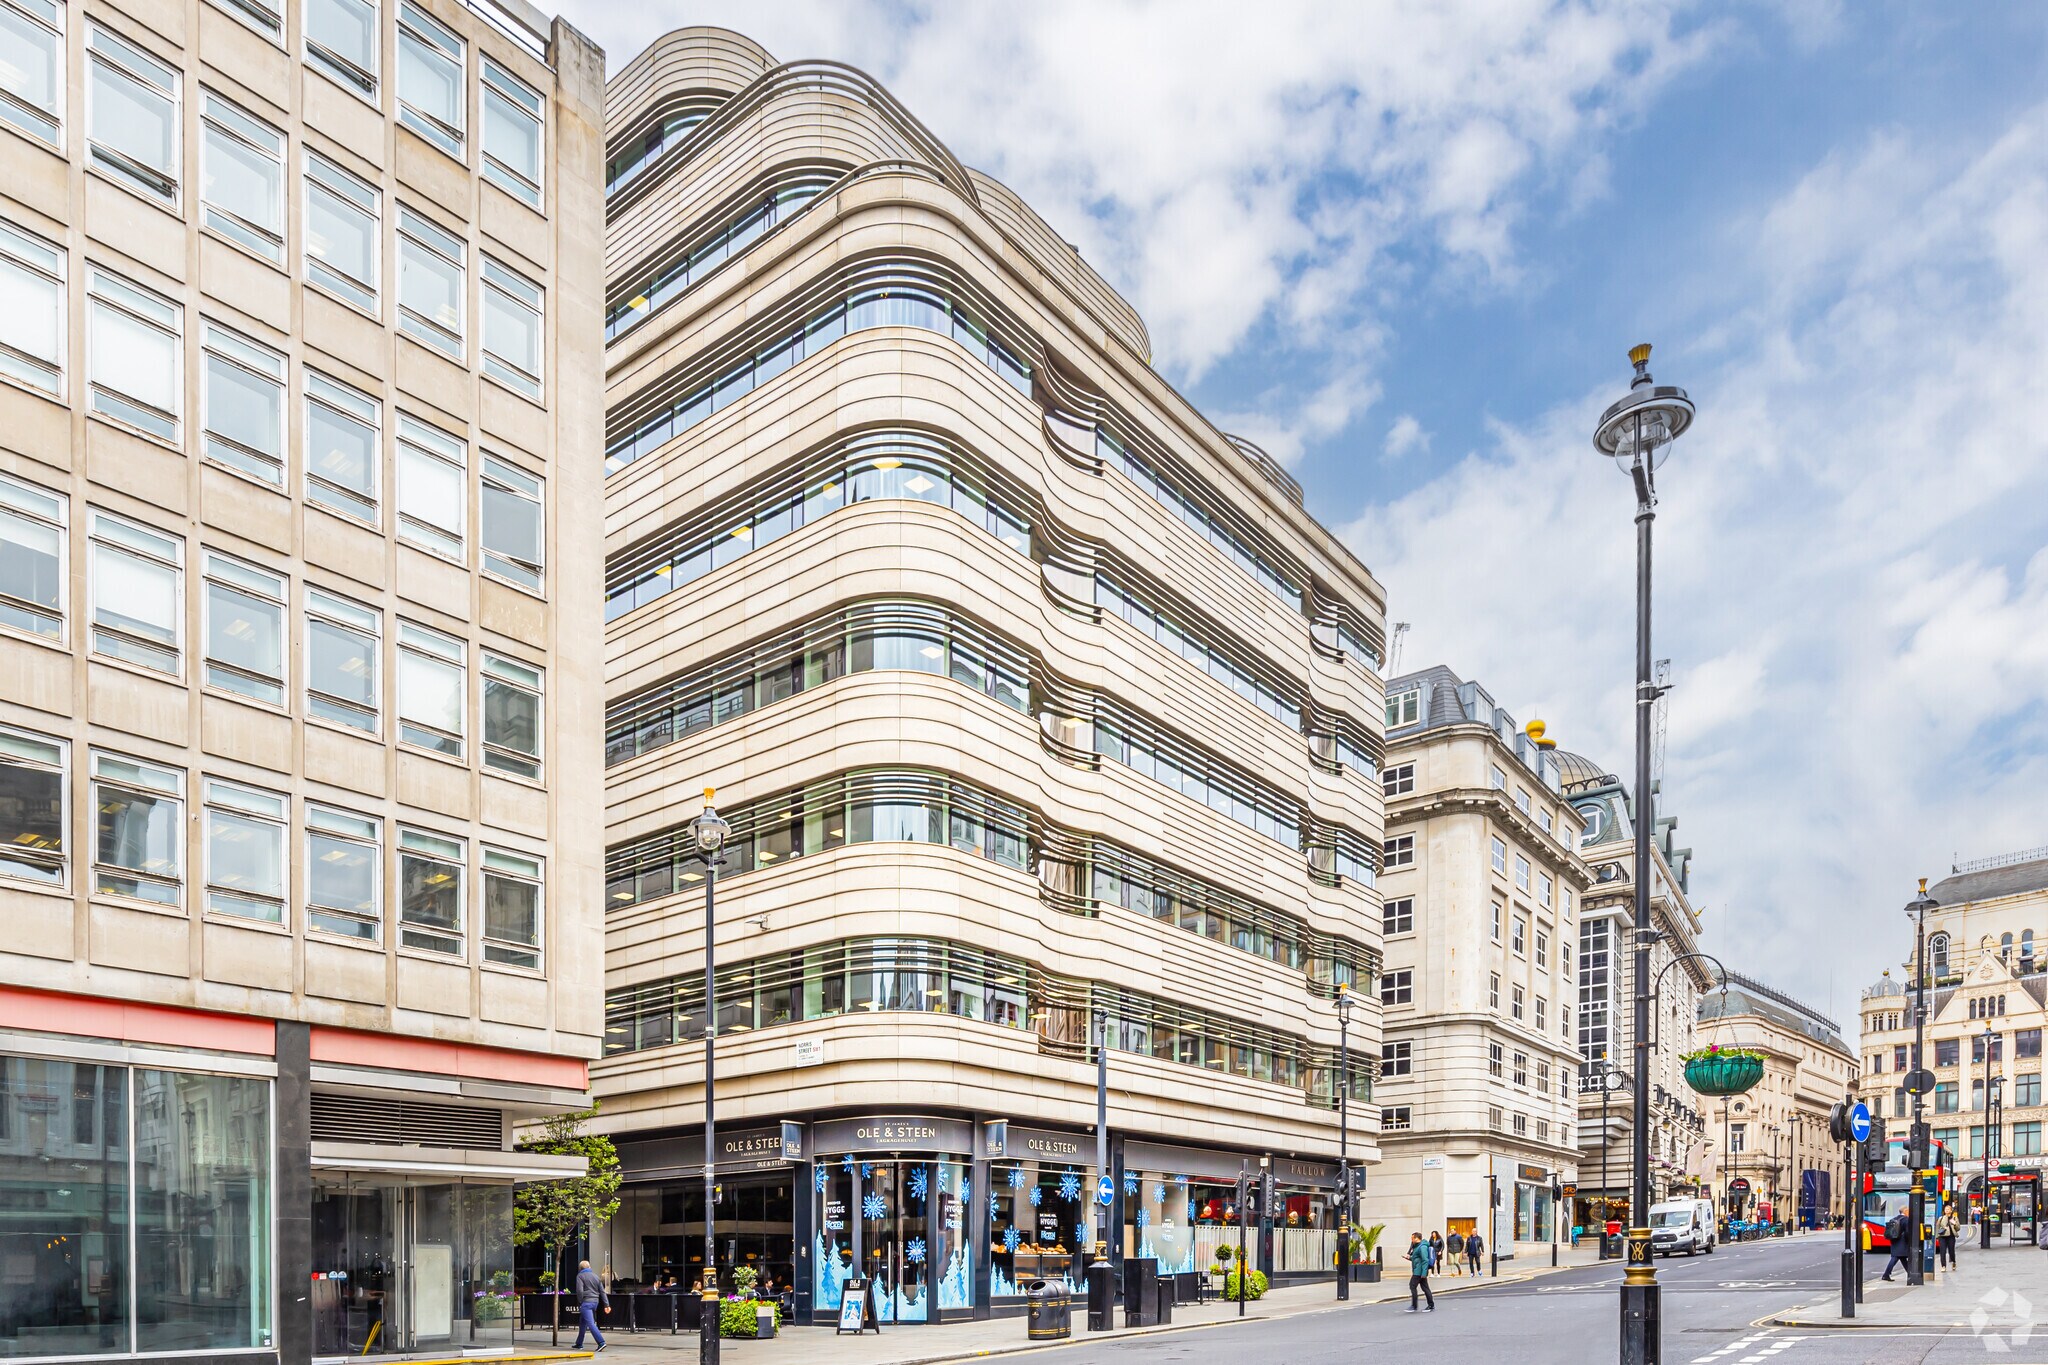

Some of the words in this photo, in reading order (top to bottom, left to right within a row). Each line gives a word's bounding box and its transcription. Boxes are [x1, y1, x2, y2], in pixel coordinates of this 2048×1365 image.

[857, 1128, 880, 1138] OLE
[884, 1127, 893, 1138] &
[897, 1127, 936, 1138] STEEN
[725, 1141, 744, 1152] OLE
[746, 1140, 753, 1150] &
[1028, 1139, 1043, 1151] OLE
[1045, 1141, 1051, 1151] &
[1053, 1142, 1077, 1153] STEEN
[2014, 1158, 2042, 1166] FIVE
[1291, 1164, 1326, 1176] FALLOW
[1880, 1175, 1908, 1183] Aldwych
[945, 1204, 964, 1213] HYGGE
[825, 1220, 844, 1230] FROZEN
[1040, 1218, 1058, 1226] HYGGE
